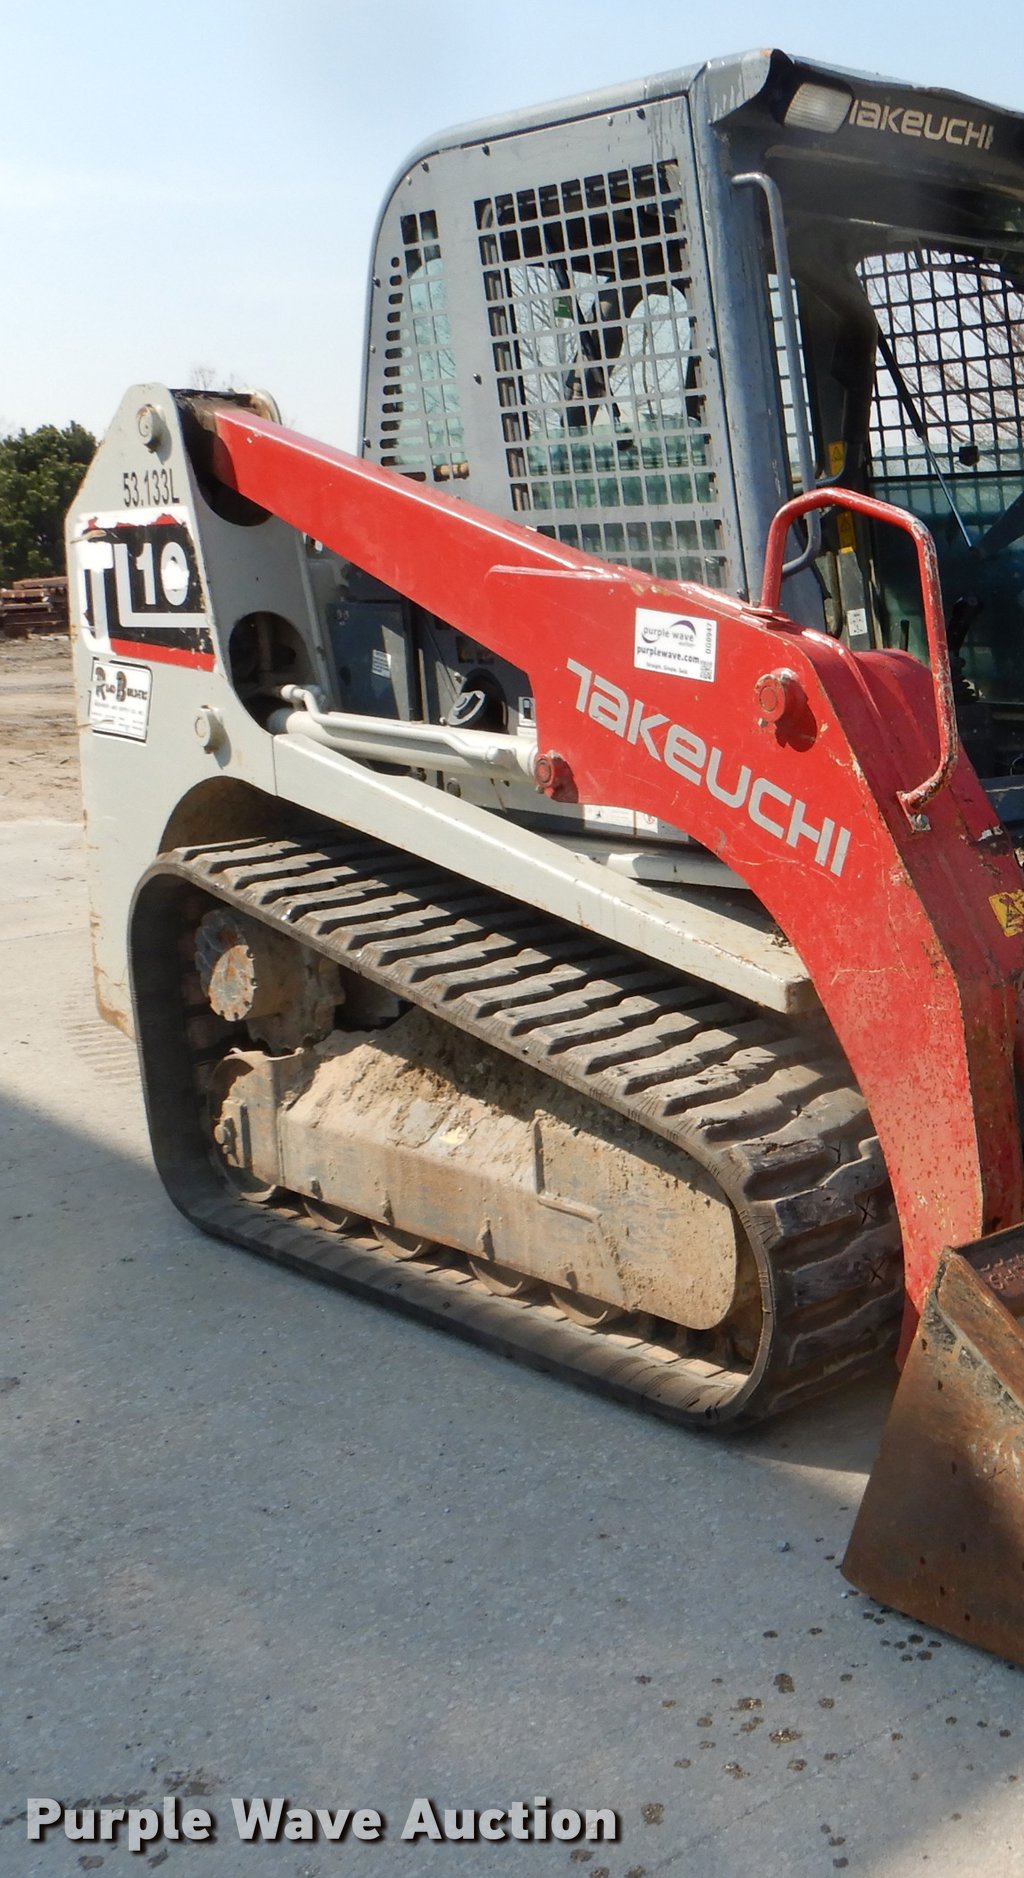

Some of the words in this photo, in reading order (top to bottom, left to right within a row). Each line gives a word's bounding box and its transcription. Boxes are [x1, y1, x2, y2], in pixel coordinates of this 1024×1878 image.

[122, 469, 180, 507] 53.133L
[643, 626, 669, 637] purple
[672, 632, 694, 642] wave
[637, 646, 699, 662] purplewave.com
